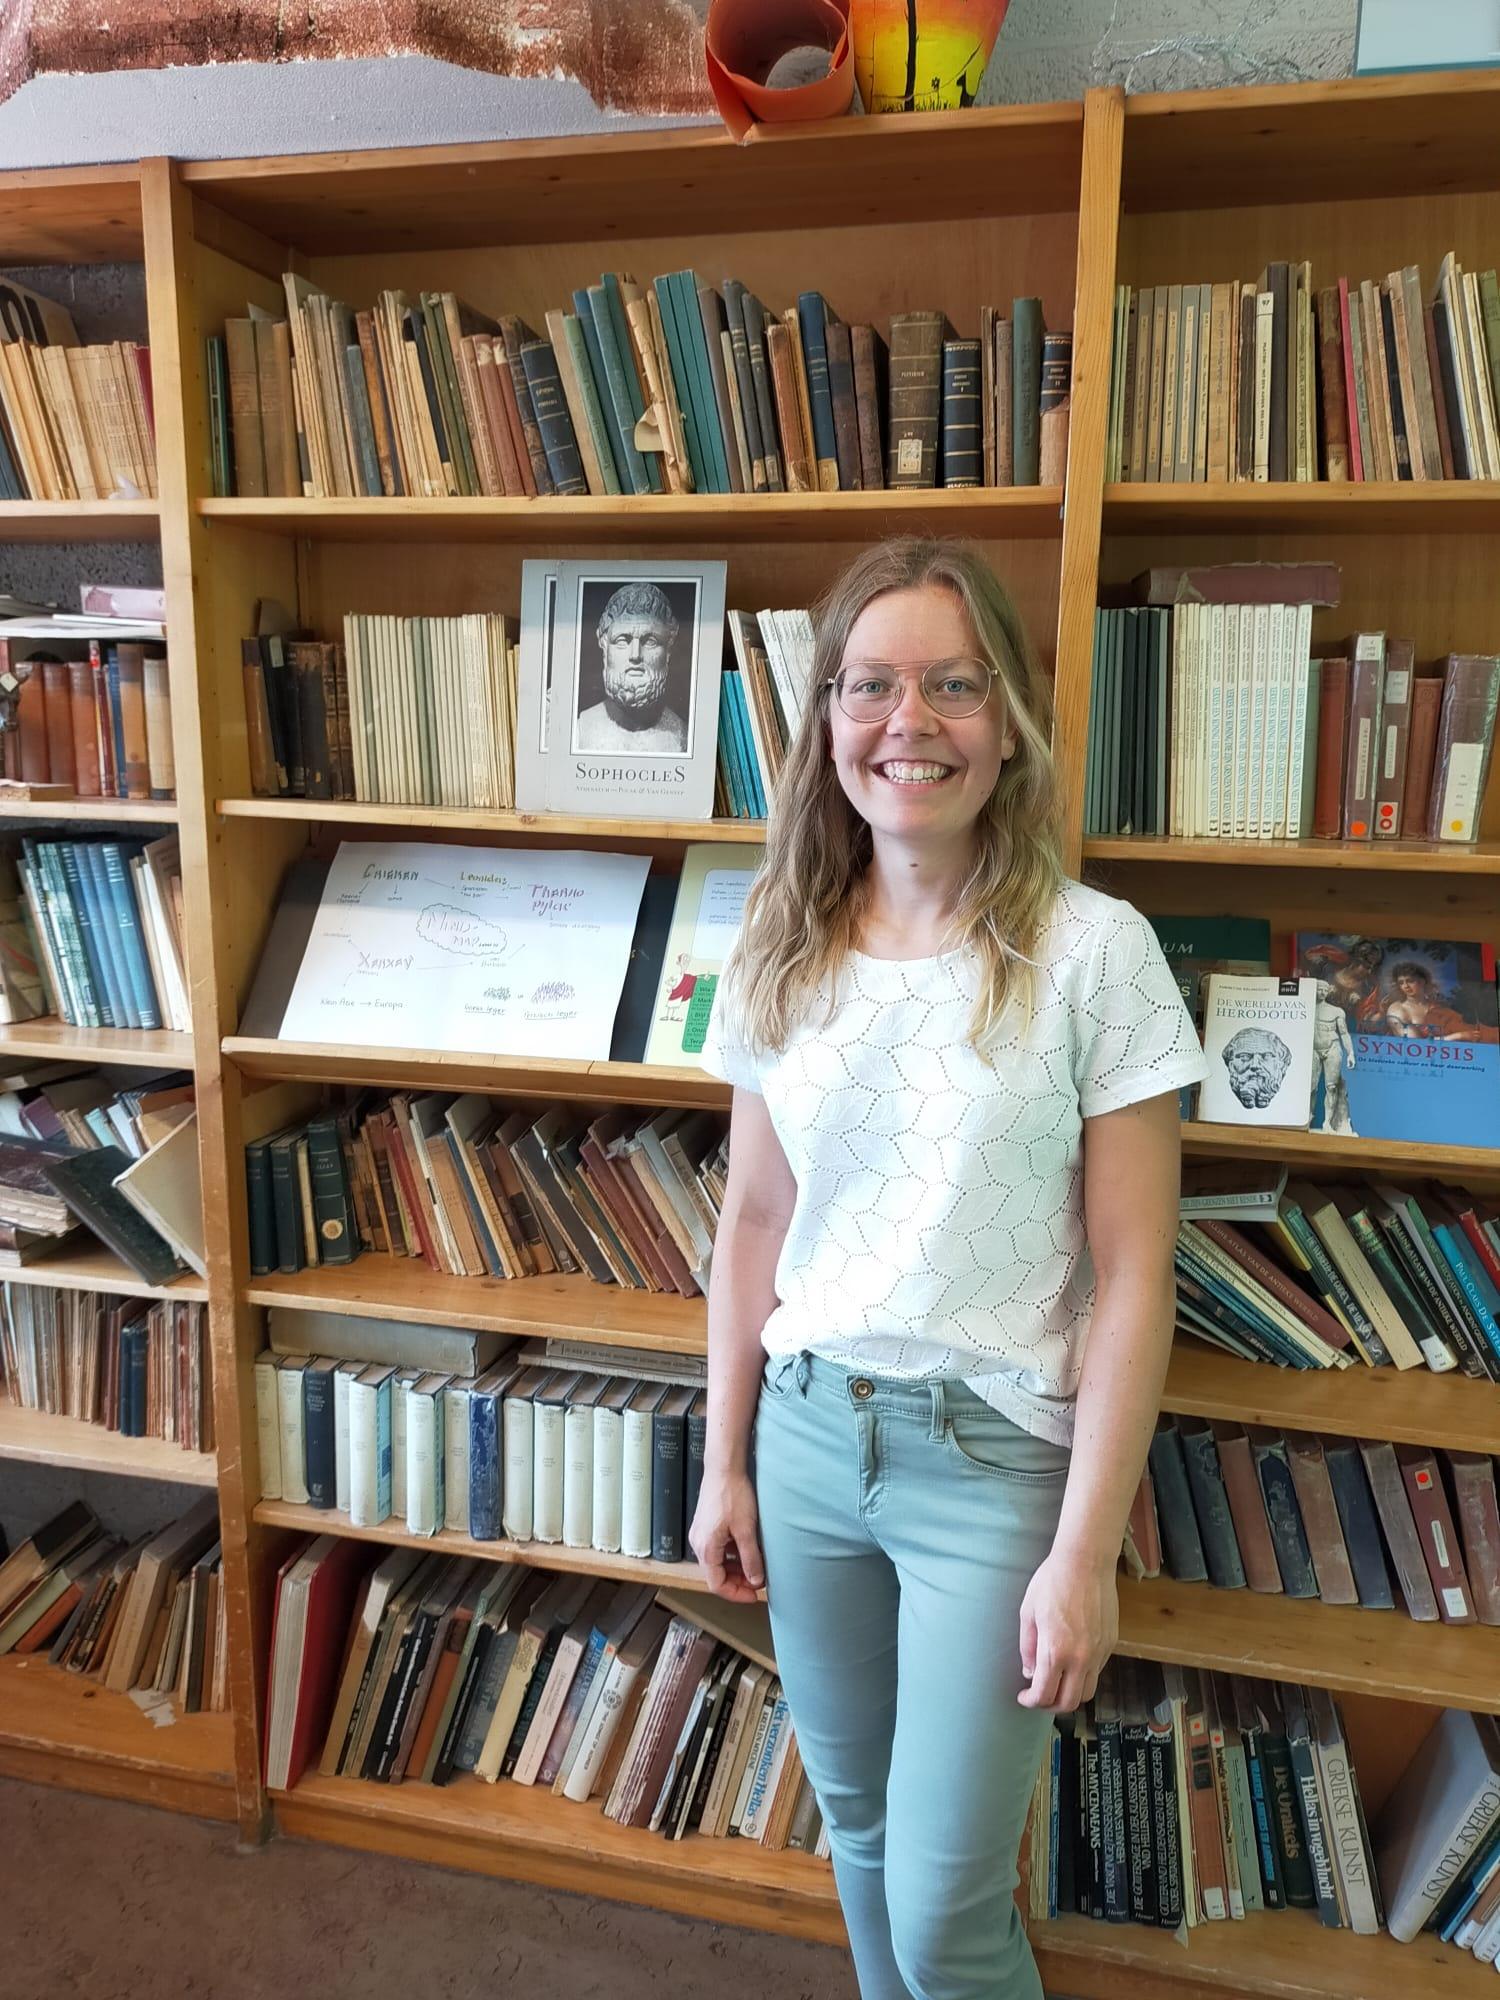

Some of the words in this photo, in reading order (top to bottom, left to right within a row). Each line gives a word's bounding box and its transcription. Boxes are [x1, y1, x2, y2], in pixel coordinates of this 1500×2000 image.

[575, 761, 685, 783] SOPHOCLES
[1216, 1007, 1308, 1020] HERODOTUS
[1217, 998, 1233, 1007] DE
[1234, 999, 1282, 1009] WERELD
[1284, 1000, 1306, 1009] VAN
[1357, 1037, 1474, 1061] SYNOPSIS
[1406, 1247, 1424, 1272] ATLAS
[1225, 1237, 1248, 1258] ATLAS
[1244, 1254, 1261, 1270] VAN
[1257, 1265, 1270, 1277] DE
[1266, 1273, 1294, 1299] ANTIEKE
[1290, 1295, 1320, 1323] WERELD
[1418, 1269, 1433, 1288] VAN
[1427, 1285, 1438, 1298] DE
[1453, 1261, 1472, 1284] PAUL
[1463, 1280, 1485, 1308] CLAES
[1477, 1306, 1491, 1321] DE
[1432, 1294, 1453, 1325] ANTIEKE
[1447, 1322, 1468, 1352] WERELD
[757, 1710, 769, 1732] KRETA
[772, 1699, 789, 1722] Het
[754, 1731, 764, 1743] EN
[755, 1721, 781, 1783] verzonken
[1086, 1751, 1098, 1772] The
[1126, 1761, 1139, 1814] KLASSISCHEN
[1272, 1764, 1290, 1789] De
[1325, 1756, 1353, 1820] GRIEKSE
[745, 1781, 767, 1818] Hellas
[1153, 1789, 1164, 1805] DER
[1299, 1774, 1321, 1818] Hellas
[1088, 1771, 1101, 1849] MYCENAEANS
[1129, 1815, 1140, 1832] DER
[1138, 1776, 1150, 1847] HELLENISTISCHEN
[1455, 1788, 1500, 1849] GRIEKSE
[1130, 1832, 1140, 1843] IN
[1154, 1806, 1167, 1865] HELDENSAGEN
[1276, 1790, 1301, 1859] Orakels
[1307, 1816, 1323, 1832] in
[1114, 1818, 1126, 1864] HERAKLES
[1307, 1831, 1335, 1901] vogelvlucht
[1338, 1824, 1366, 1889] KUNST
[1419, 1846, 1466, 1905] KUNST
[1105, 1889, 1115, 1904] DIE
[1133, 1895, 1143, 1910] DIE
